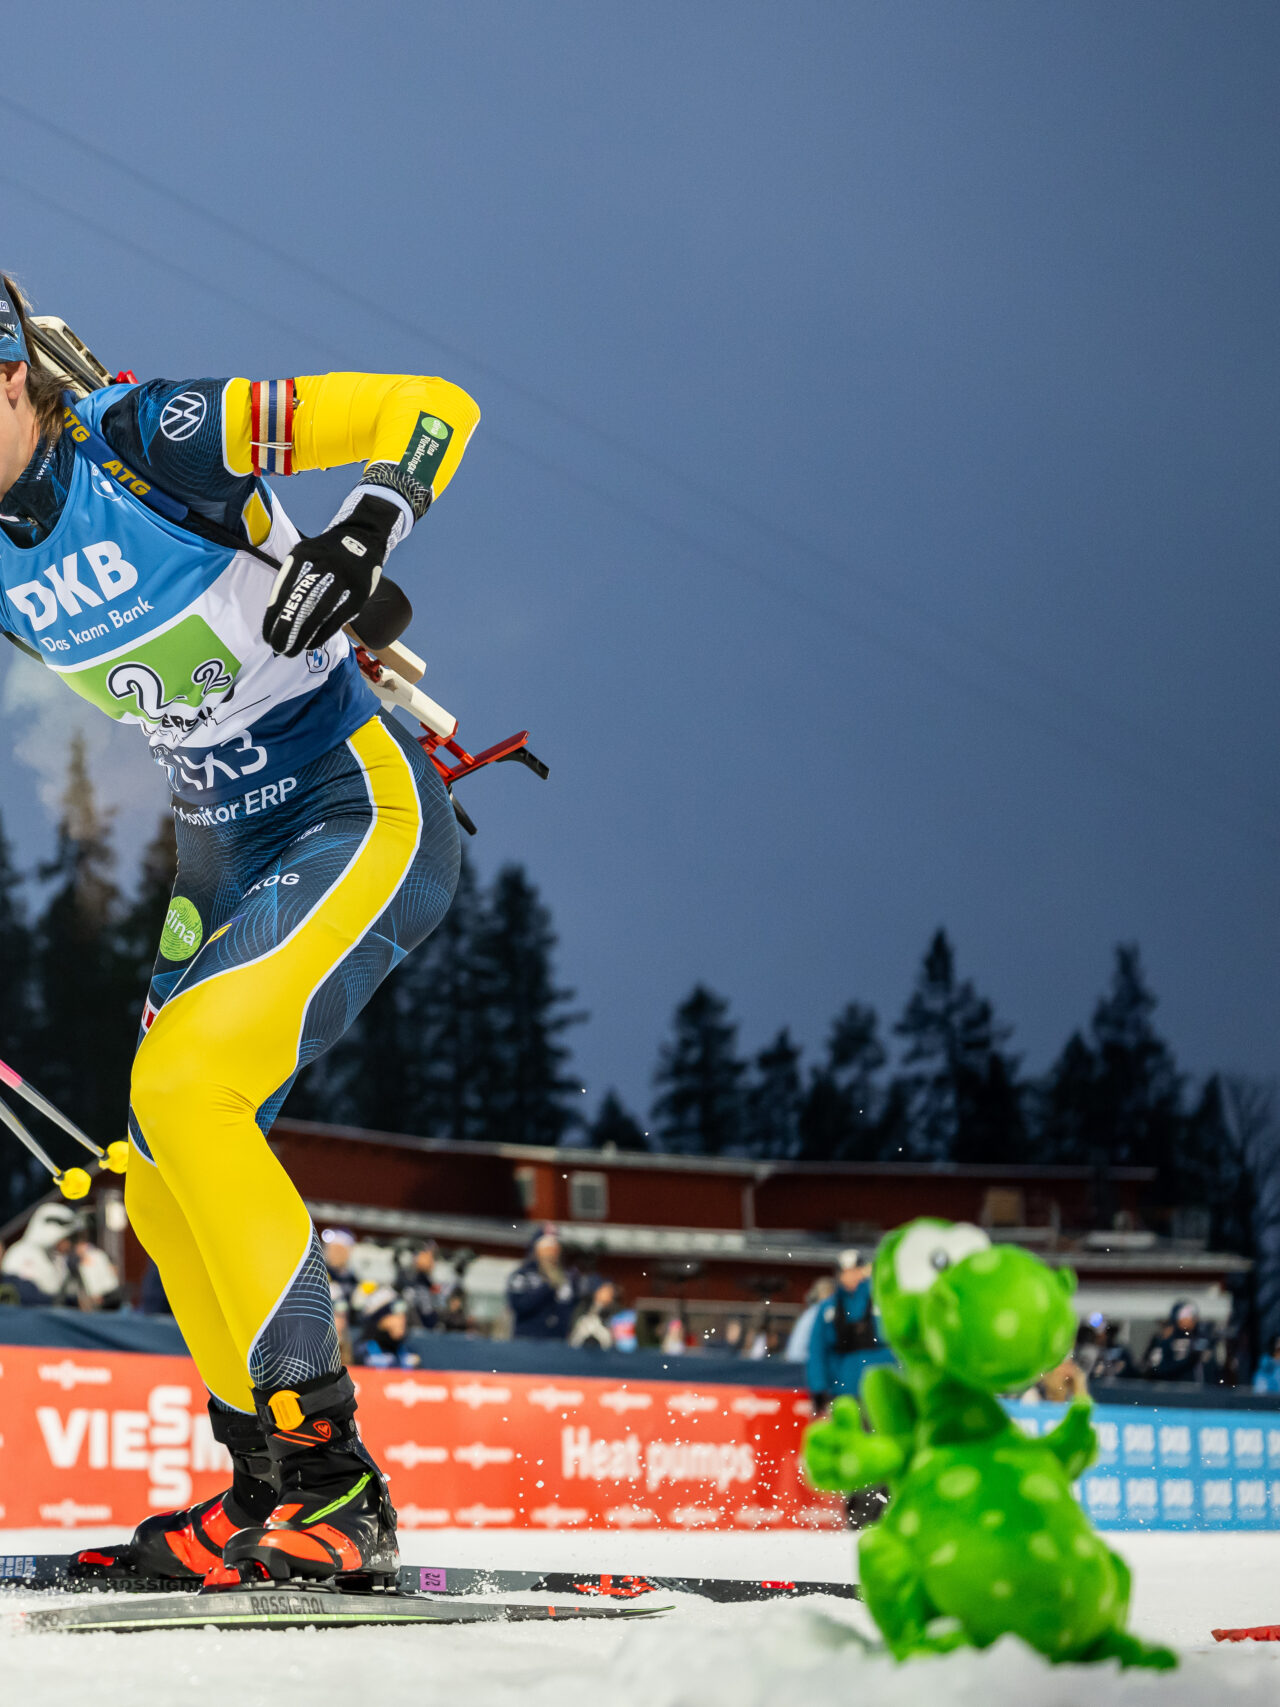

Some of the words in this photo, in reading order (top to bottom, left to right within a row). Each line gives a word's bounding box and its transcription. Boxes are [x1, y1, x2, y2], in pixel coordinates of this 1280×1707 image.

[102, 460, 151, 496] ATG
[6, 540, 139, 632] DKB
[280, 573, 321, 623] HESTRA
[40, 636, 71, 653] Das
[70, 622, 110, 646] kann
[107, 595, 155, 629] Bank
[107, 662, 186, 721] 2
[191, 658, 233, 697] 2
[244, 776, 298, 816] ERP
[165, 908, 196, 947] dina
[562, 1424, 642, 1480] Heat
[646, 1440, 756, 1494] pumps
